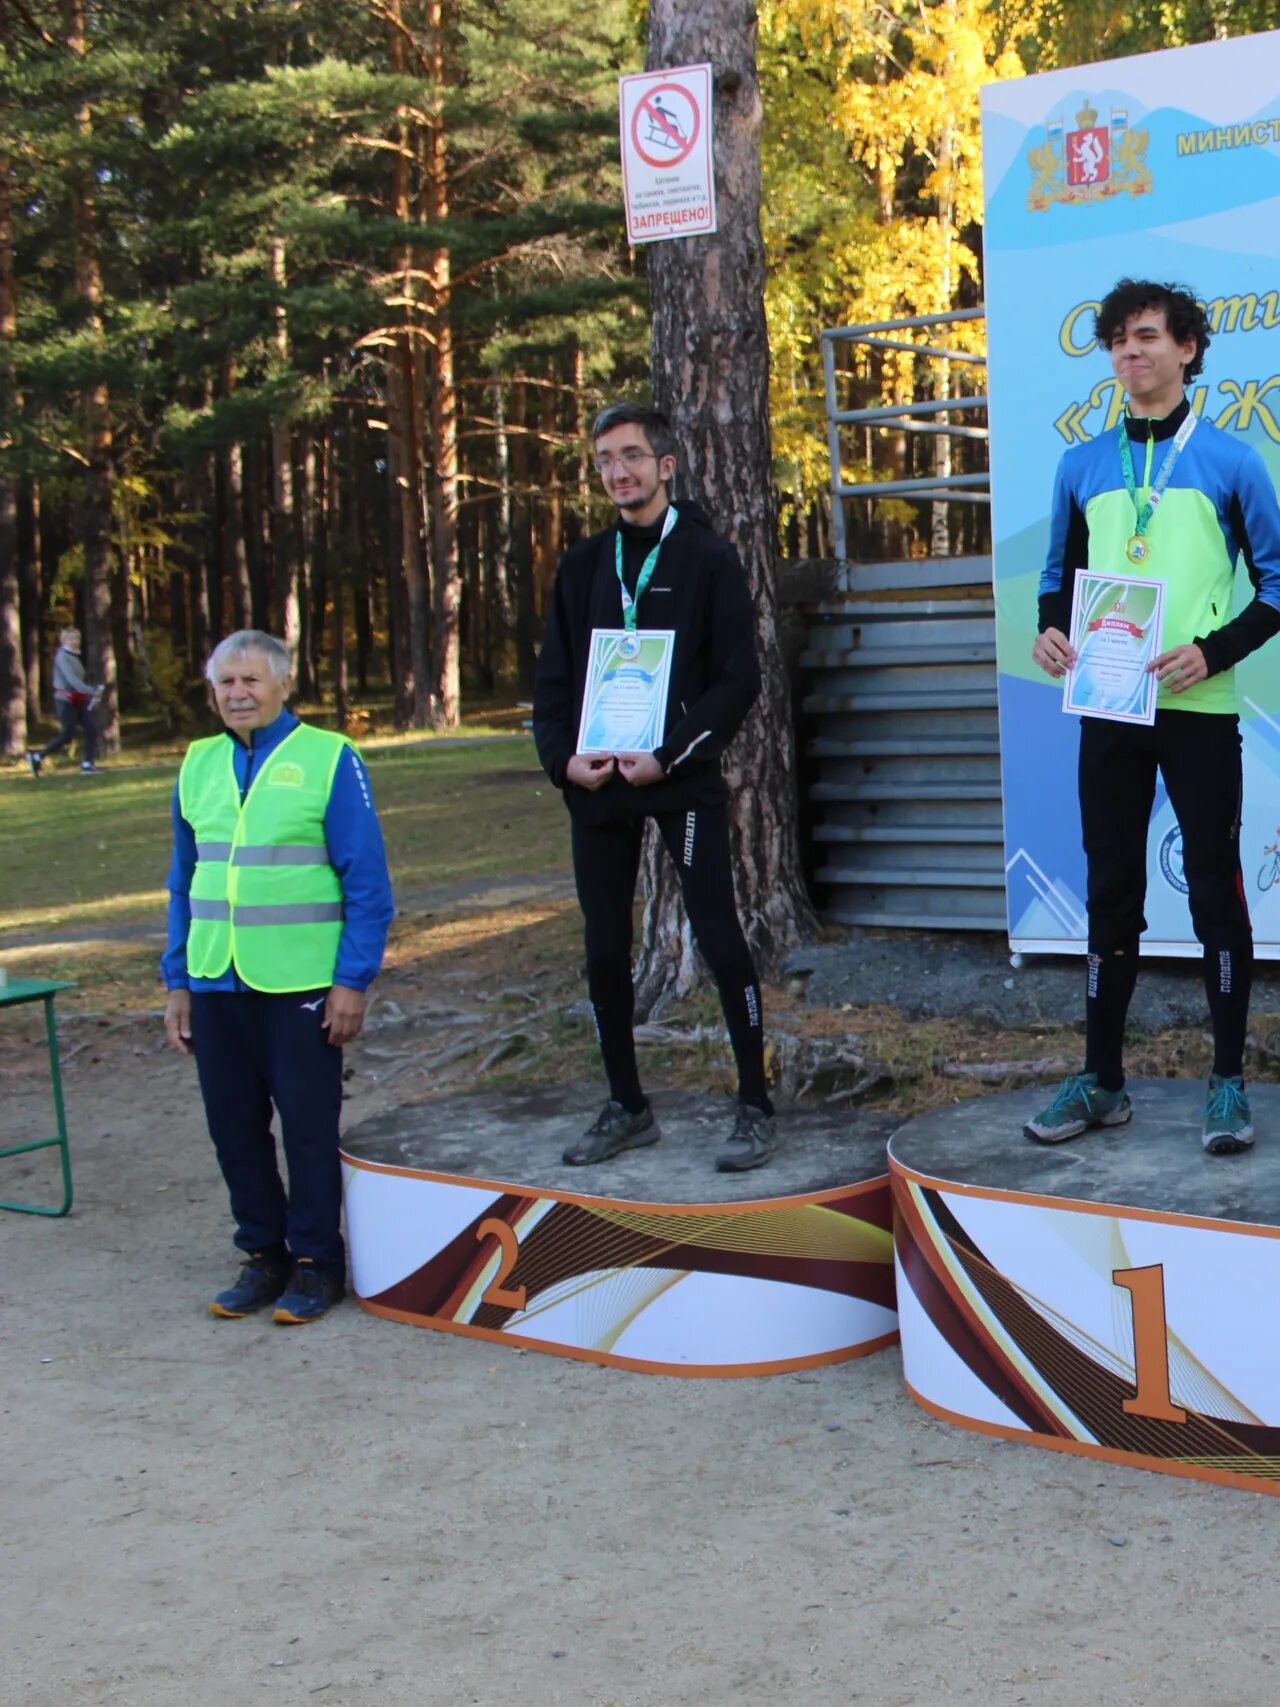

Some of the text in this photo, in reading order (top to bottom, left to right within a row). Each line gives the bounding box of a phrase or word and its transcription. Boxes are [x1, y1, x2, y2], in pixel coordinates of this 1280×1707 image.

[632, 207, 708, 230] ЗАПРЕЩЕНО!
[475, 1216, 527, 1313] 2
[1111, 1261, 1187, 1425] 1
